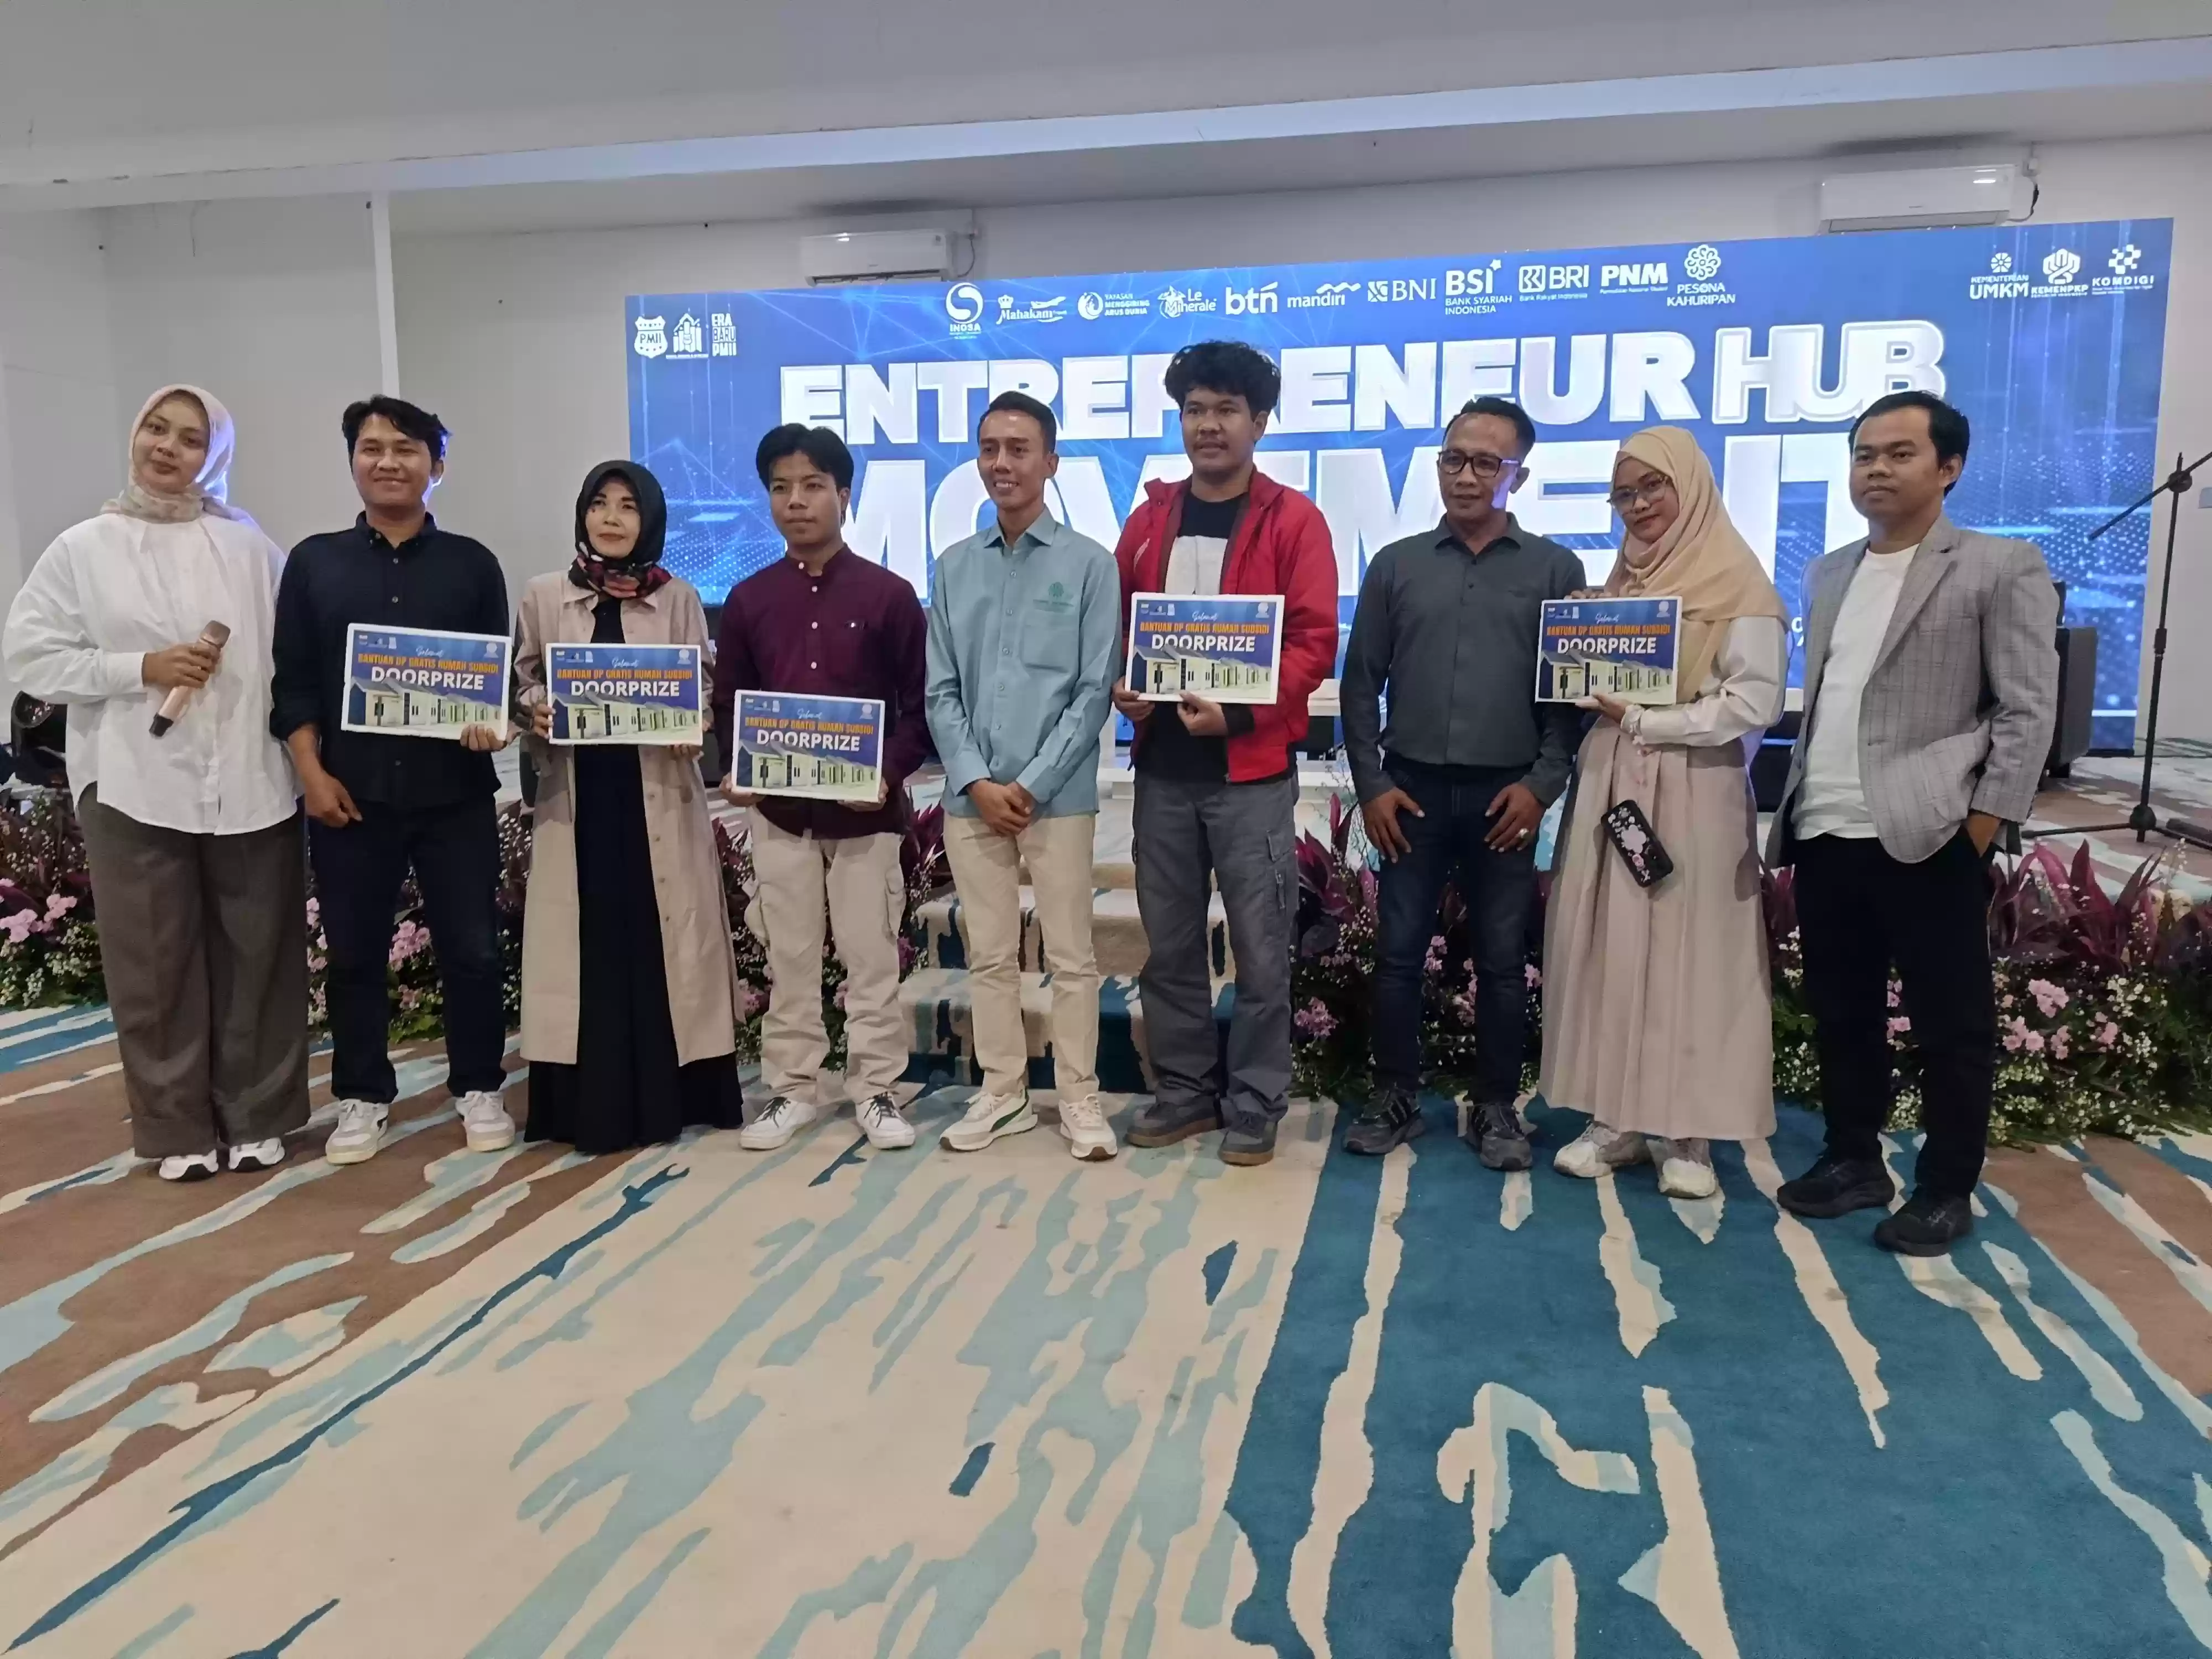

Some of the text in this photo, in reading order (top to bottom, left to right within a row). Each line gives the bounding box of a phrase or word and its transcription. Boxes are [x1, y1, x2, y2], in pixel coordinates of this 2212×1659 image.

[1445, 268, 1494, 296] BSI
[1549, 265, 1589, 289] BRI
[1601, 263, 1668, 286] PNM
[2092, 275, 2154, 286] KOMDIGI
[1187, 288, 1202, 301] Le
[1392, 278, 1437, 302] BNI
[1677, 283, 1725, 294] PESONA
[1969, 282, 2030, 299] UMKM
[1225, 281, 1278, 315] btn
[1287, 291, 1346, 309] mandiri
[1445, 295, 1512, 307] BANK SYARIAH
[1667, 294, 1736, 306] KAHURIPAN
[996, 307, 1053, 325] Mahakam
[1445, 306, 1497, 315] INDONESIA
[711, 313, 733, 326] ERA
[640, 333, 661, 344] PMII
[712, 326, 737, 341] BARU
[780, 320, 1945, 446] ENTREPENEUR HUB
[1151, 634, 1255, 653] DOORPRIZE
[1557, 637, 1656, 654] DOORPRIZE
[372, 666, 484, 690] DOORPRIZE
[571, 681, 680, 697] DOORPRIZE
[757, 729, 860, 752] DOORPRIZE
